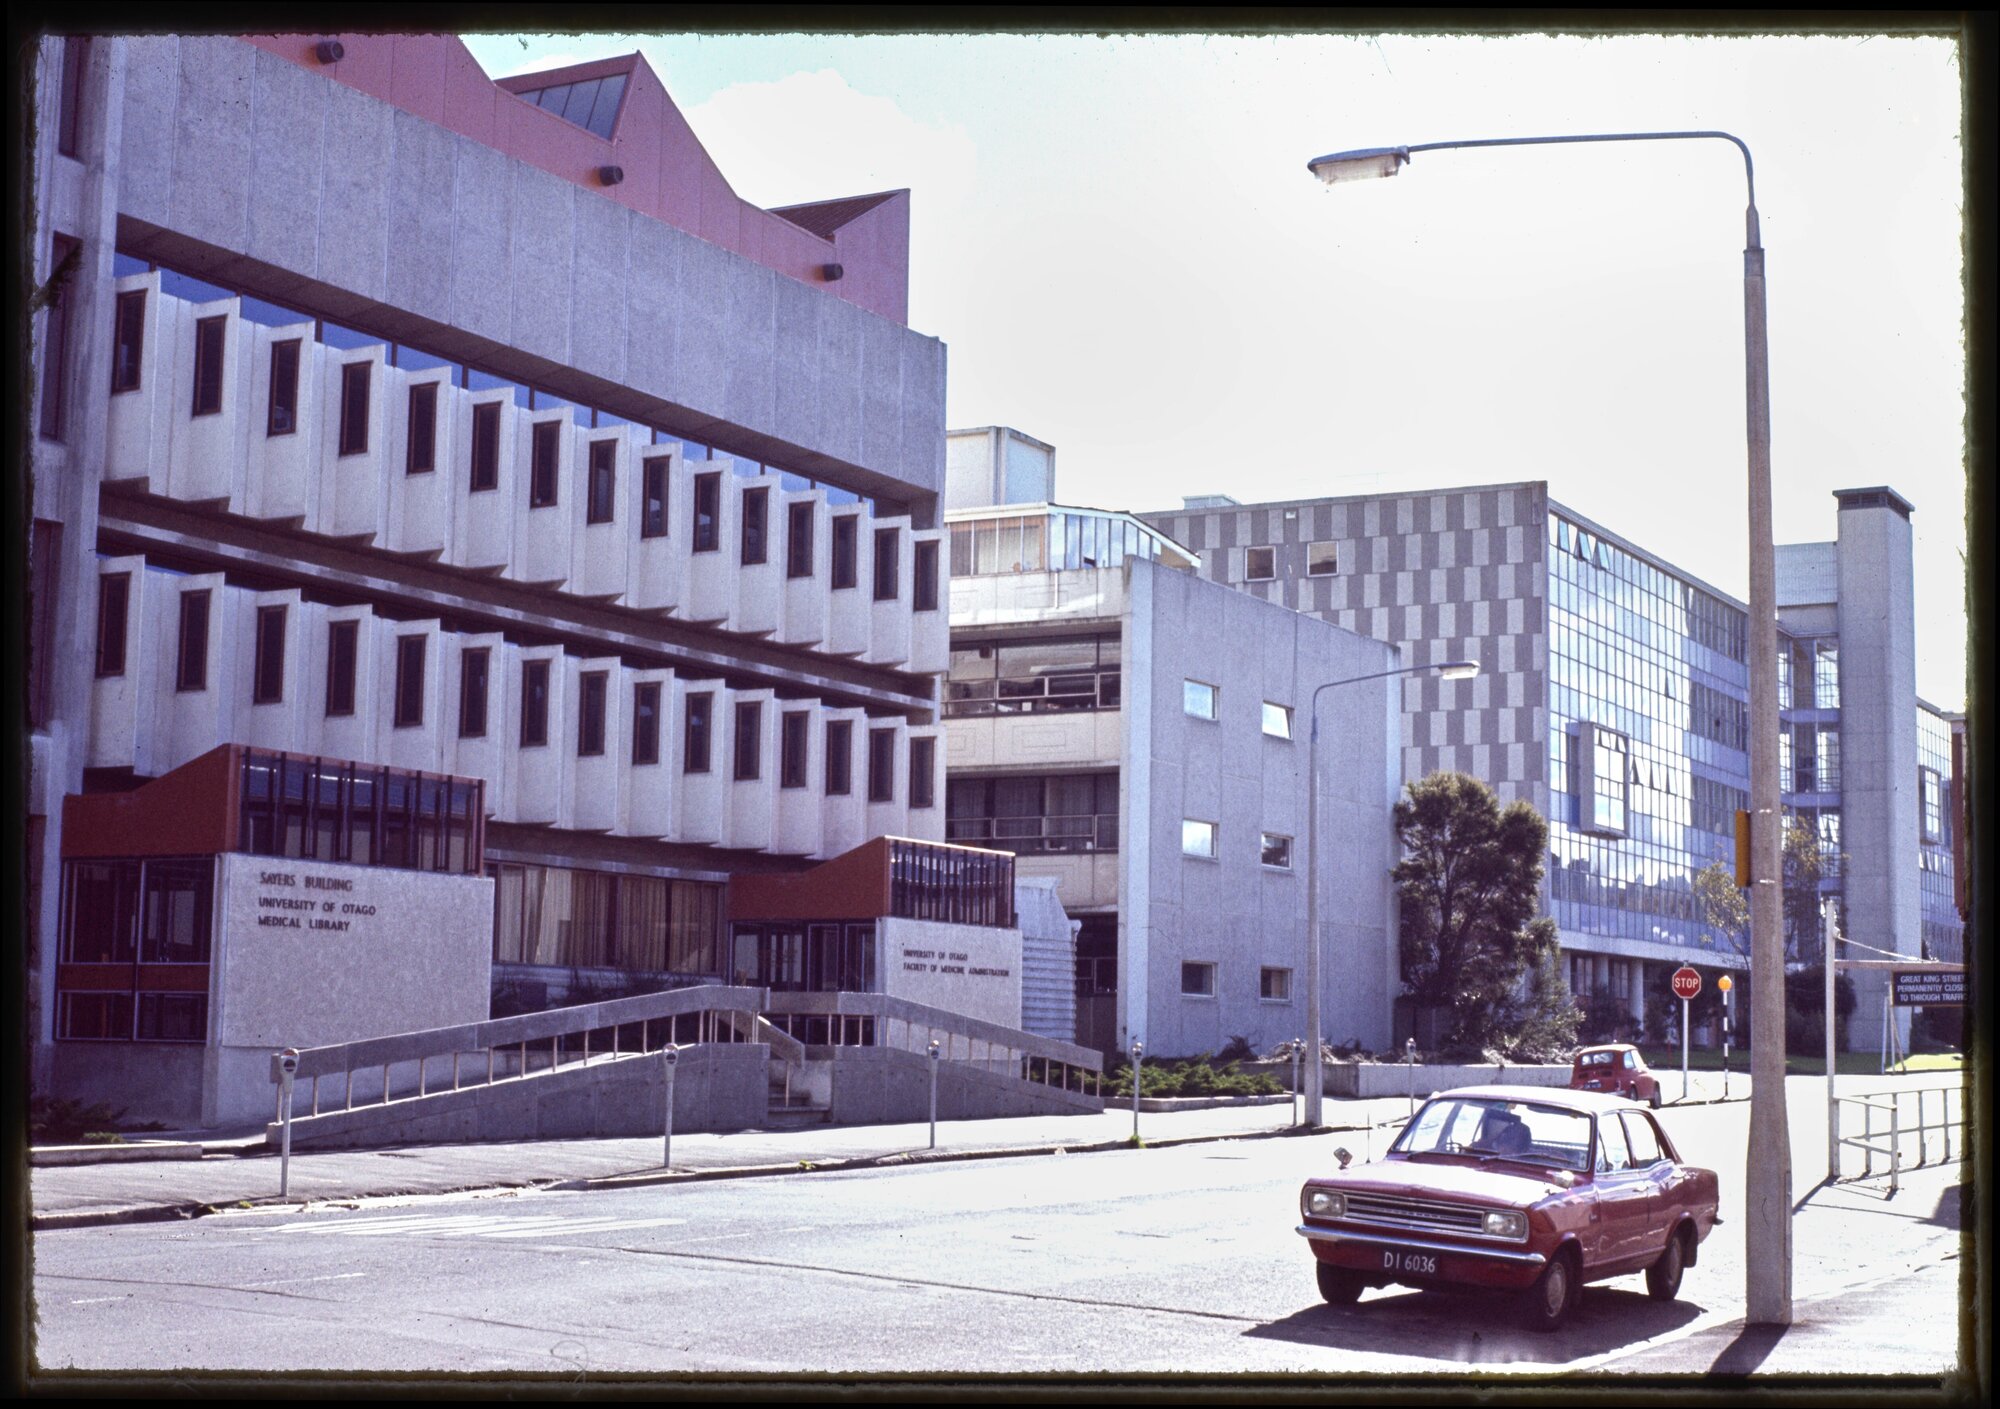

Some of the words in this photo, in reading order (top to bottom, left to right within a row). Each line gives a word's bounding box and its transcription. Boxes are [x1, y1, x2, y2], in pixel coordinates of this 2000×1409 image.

[261, 871, 296, 887] SAYERS
[304, 875, 353, 892] BUILDING
[258, 897, 316, 911] UNIVERSITY
[322, 901, 336, 912] OF
[342, 903, 377, 916] OTAGO
[258, 915, 301, 928] MEDICAL
[309, 919, 350, 931] LIBRARY
[903, 949, 935, 958] UNIVERSITY
[949, 952, 967, 961] OTAGO
[903, 962, 926, 972] FACULTY
[930, 964, 937, 972] OF
[940, 965, 965, 974] MEDICINE
[968, 968, 1010, 977] ADMINISTRATION
[1674, 977, 1698, 989] STOP
[1900, 975, 1921, 983] GREAT
[1923, 975, 1940, 983] KING
[1896, 984, 1942, 993] PERMANENTLY
[1404, 1255, 1436, 1273] 6036
